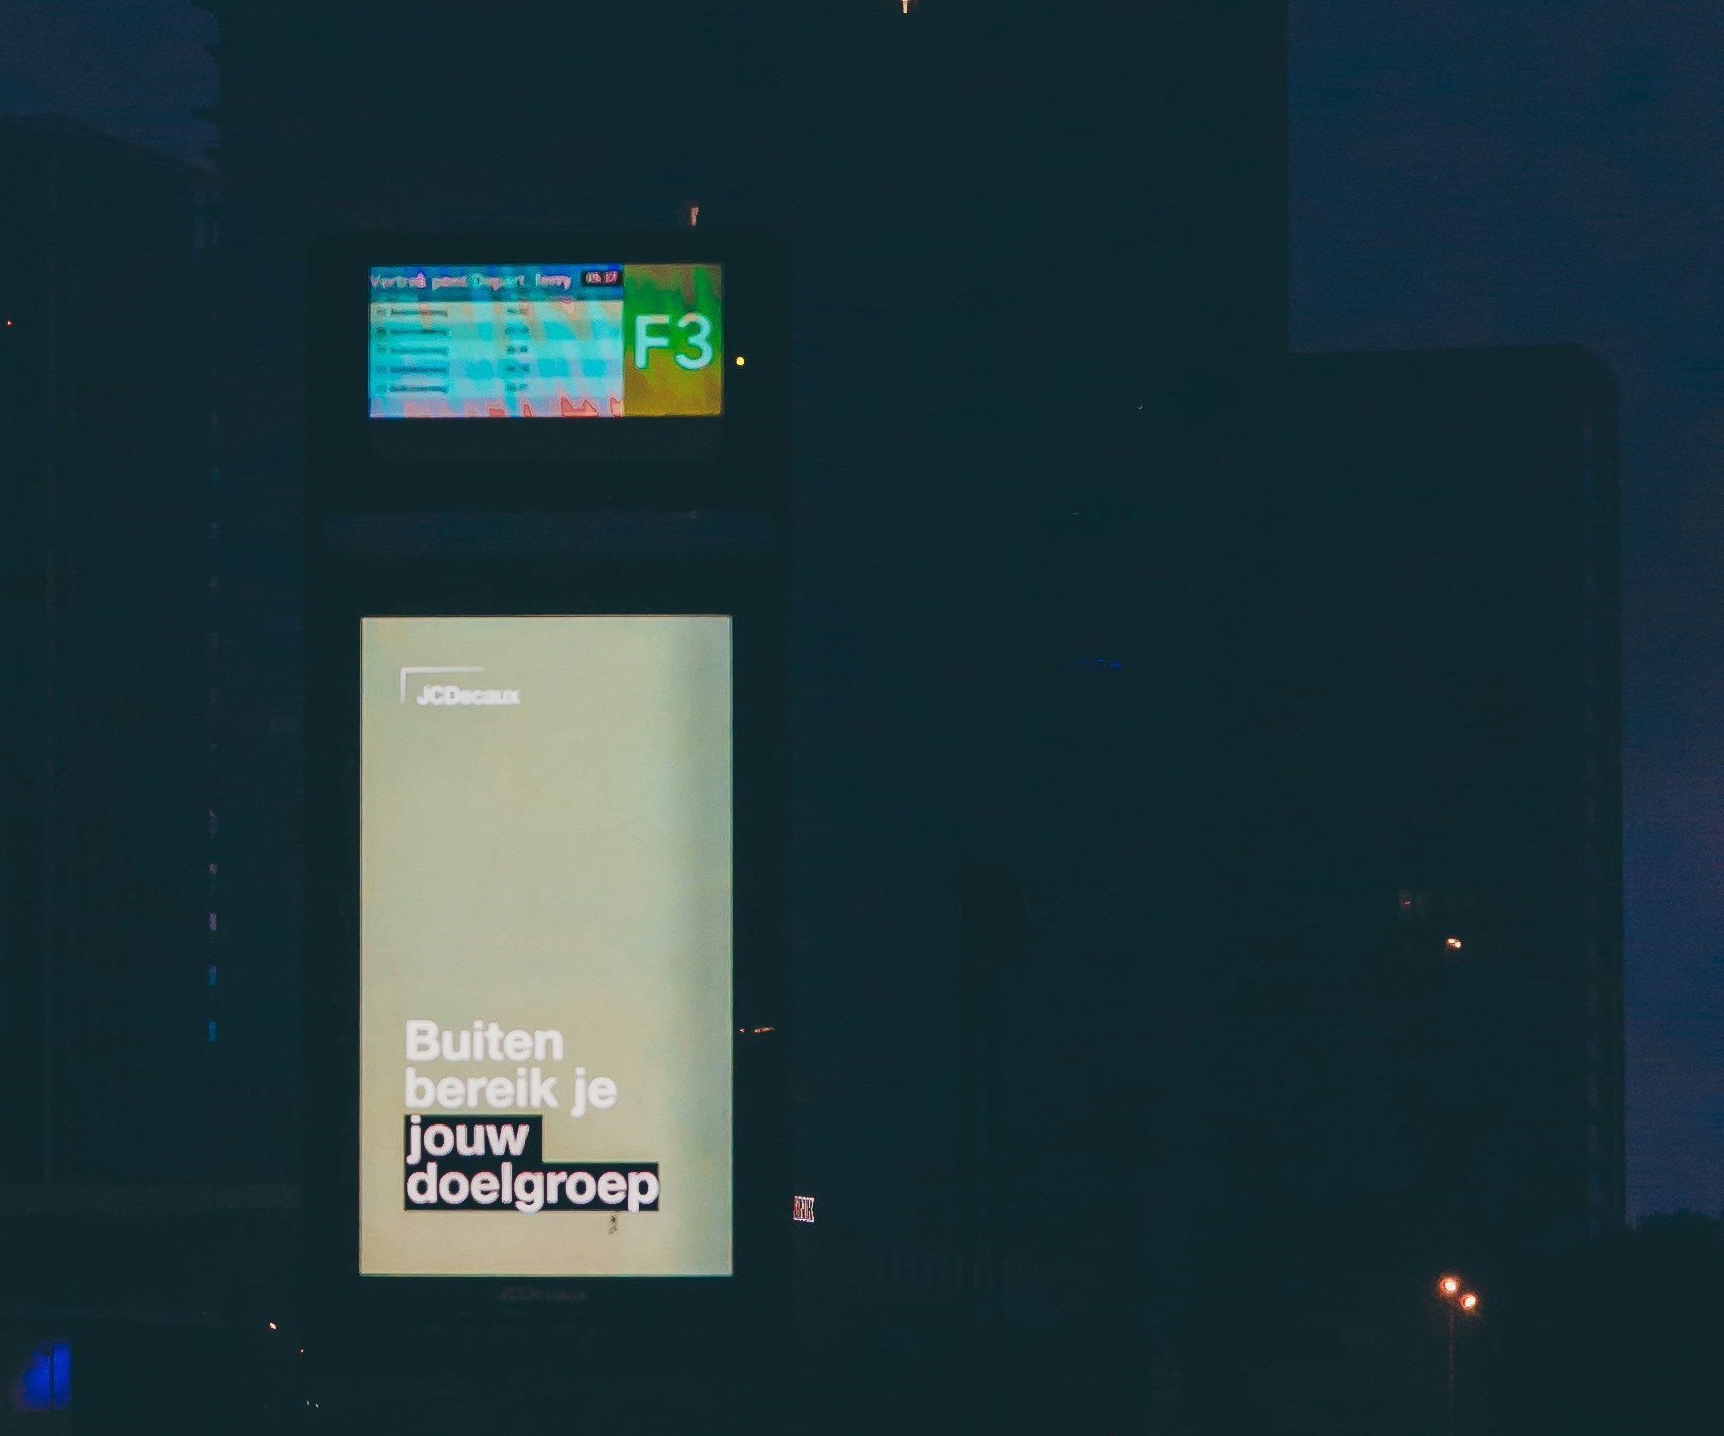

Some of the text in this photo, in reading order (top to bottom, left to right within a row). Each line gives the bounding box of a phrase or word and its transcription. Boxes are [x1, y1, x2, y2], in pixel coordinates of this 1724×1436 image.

[634, 314, 714, 370] F3
[405, 1019, 564, 1062] Buiten
[405, 1066, 618, 1119] bereik je
[406, 1114, 530, 1165] jouw
[407, 1161, 660, 1213] doelgroep
